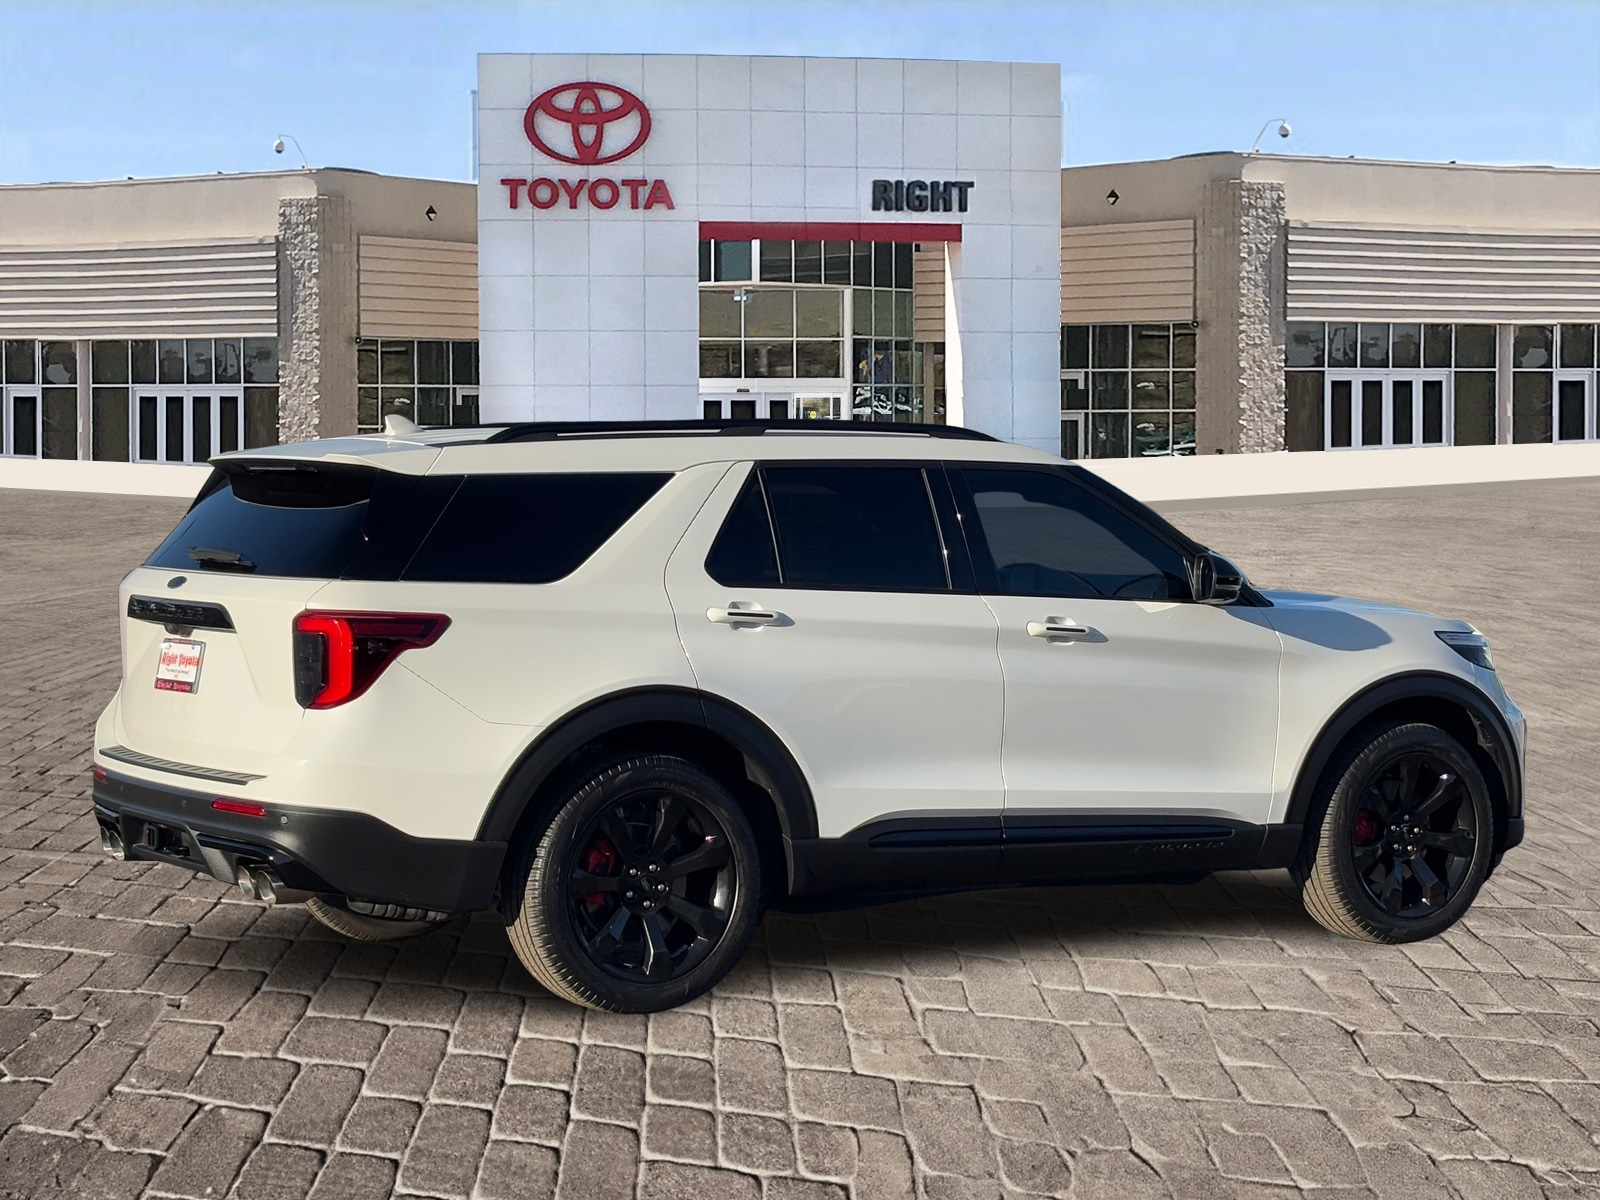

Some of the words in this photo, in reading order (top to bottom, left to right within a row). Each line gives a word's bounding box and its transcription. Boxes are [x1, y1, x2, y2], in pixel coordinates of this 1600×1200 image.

[500, 177, 675, 210] TOYOTA
[871, 179, 975, 213] RIGHT
[161, 651, 178, 667] Right
[179, 653, 200, 668] Toyota
